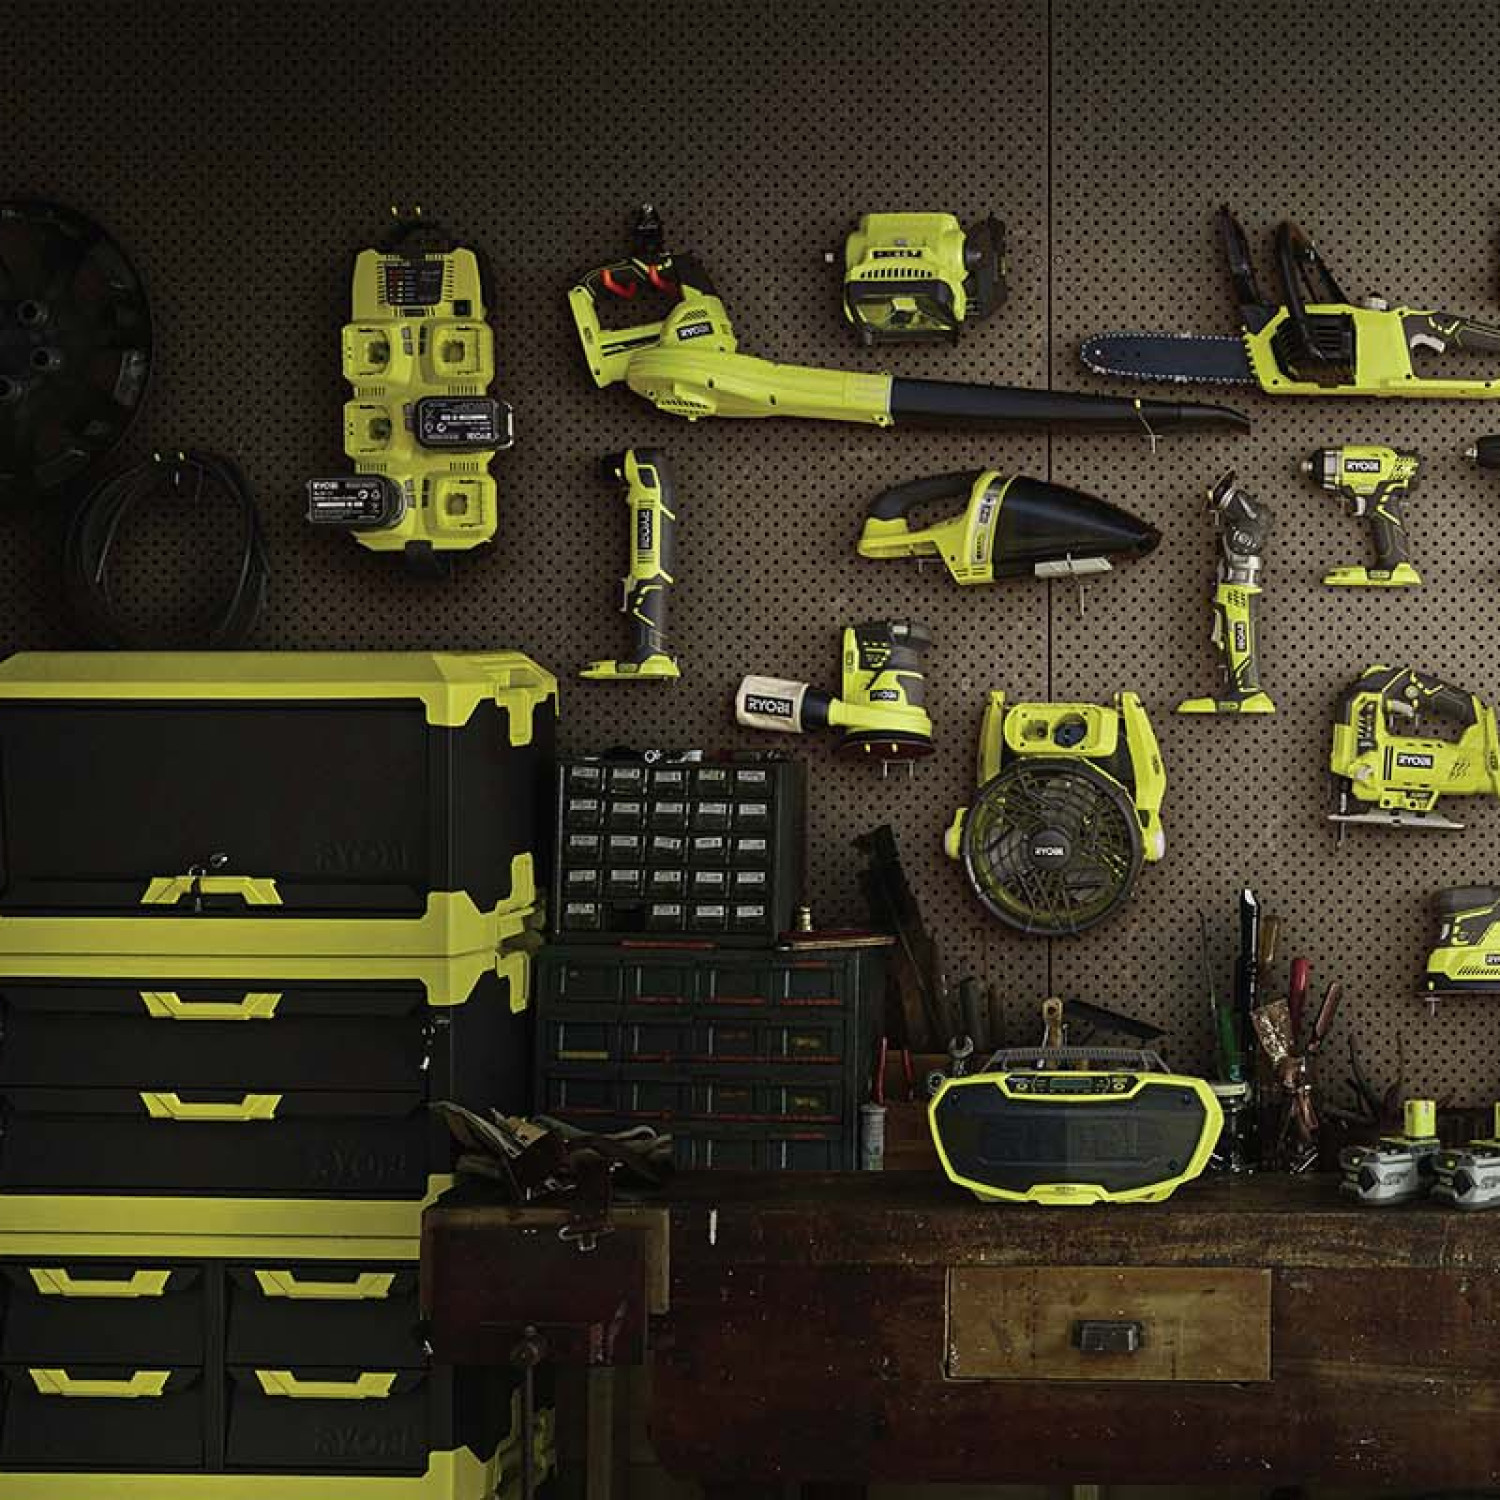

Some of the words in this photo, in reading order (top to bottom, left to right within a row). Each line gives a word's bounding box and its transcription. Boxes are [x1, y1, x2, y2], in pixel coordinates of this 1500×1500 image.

[681, 324, 711, 338] RYOBI
[1347, 461, 1379, 471] RYOBI
[640, 510, 650, 548] RYOBI
[872, 691, 897, 699] RYOBI
[747, 695, 790, 714] RYOBI
[1400, 757, 1432, 766] RYOBI
[1034, 846, 1064, 856] RYOBI
